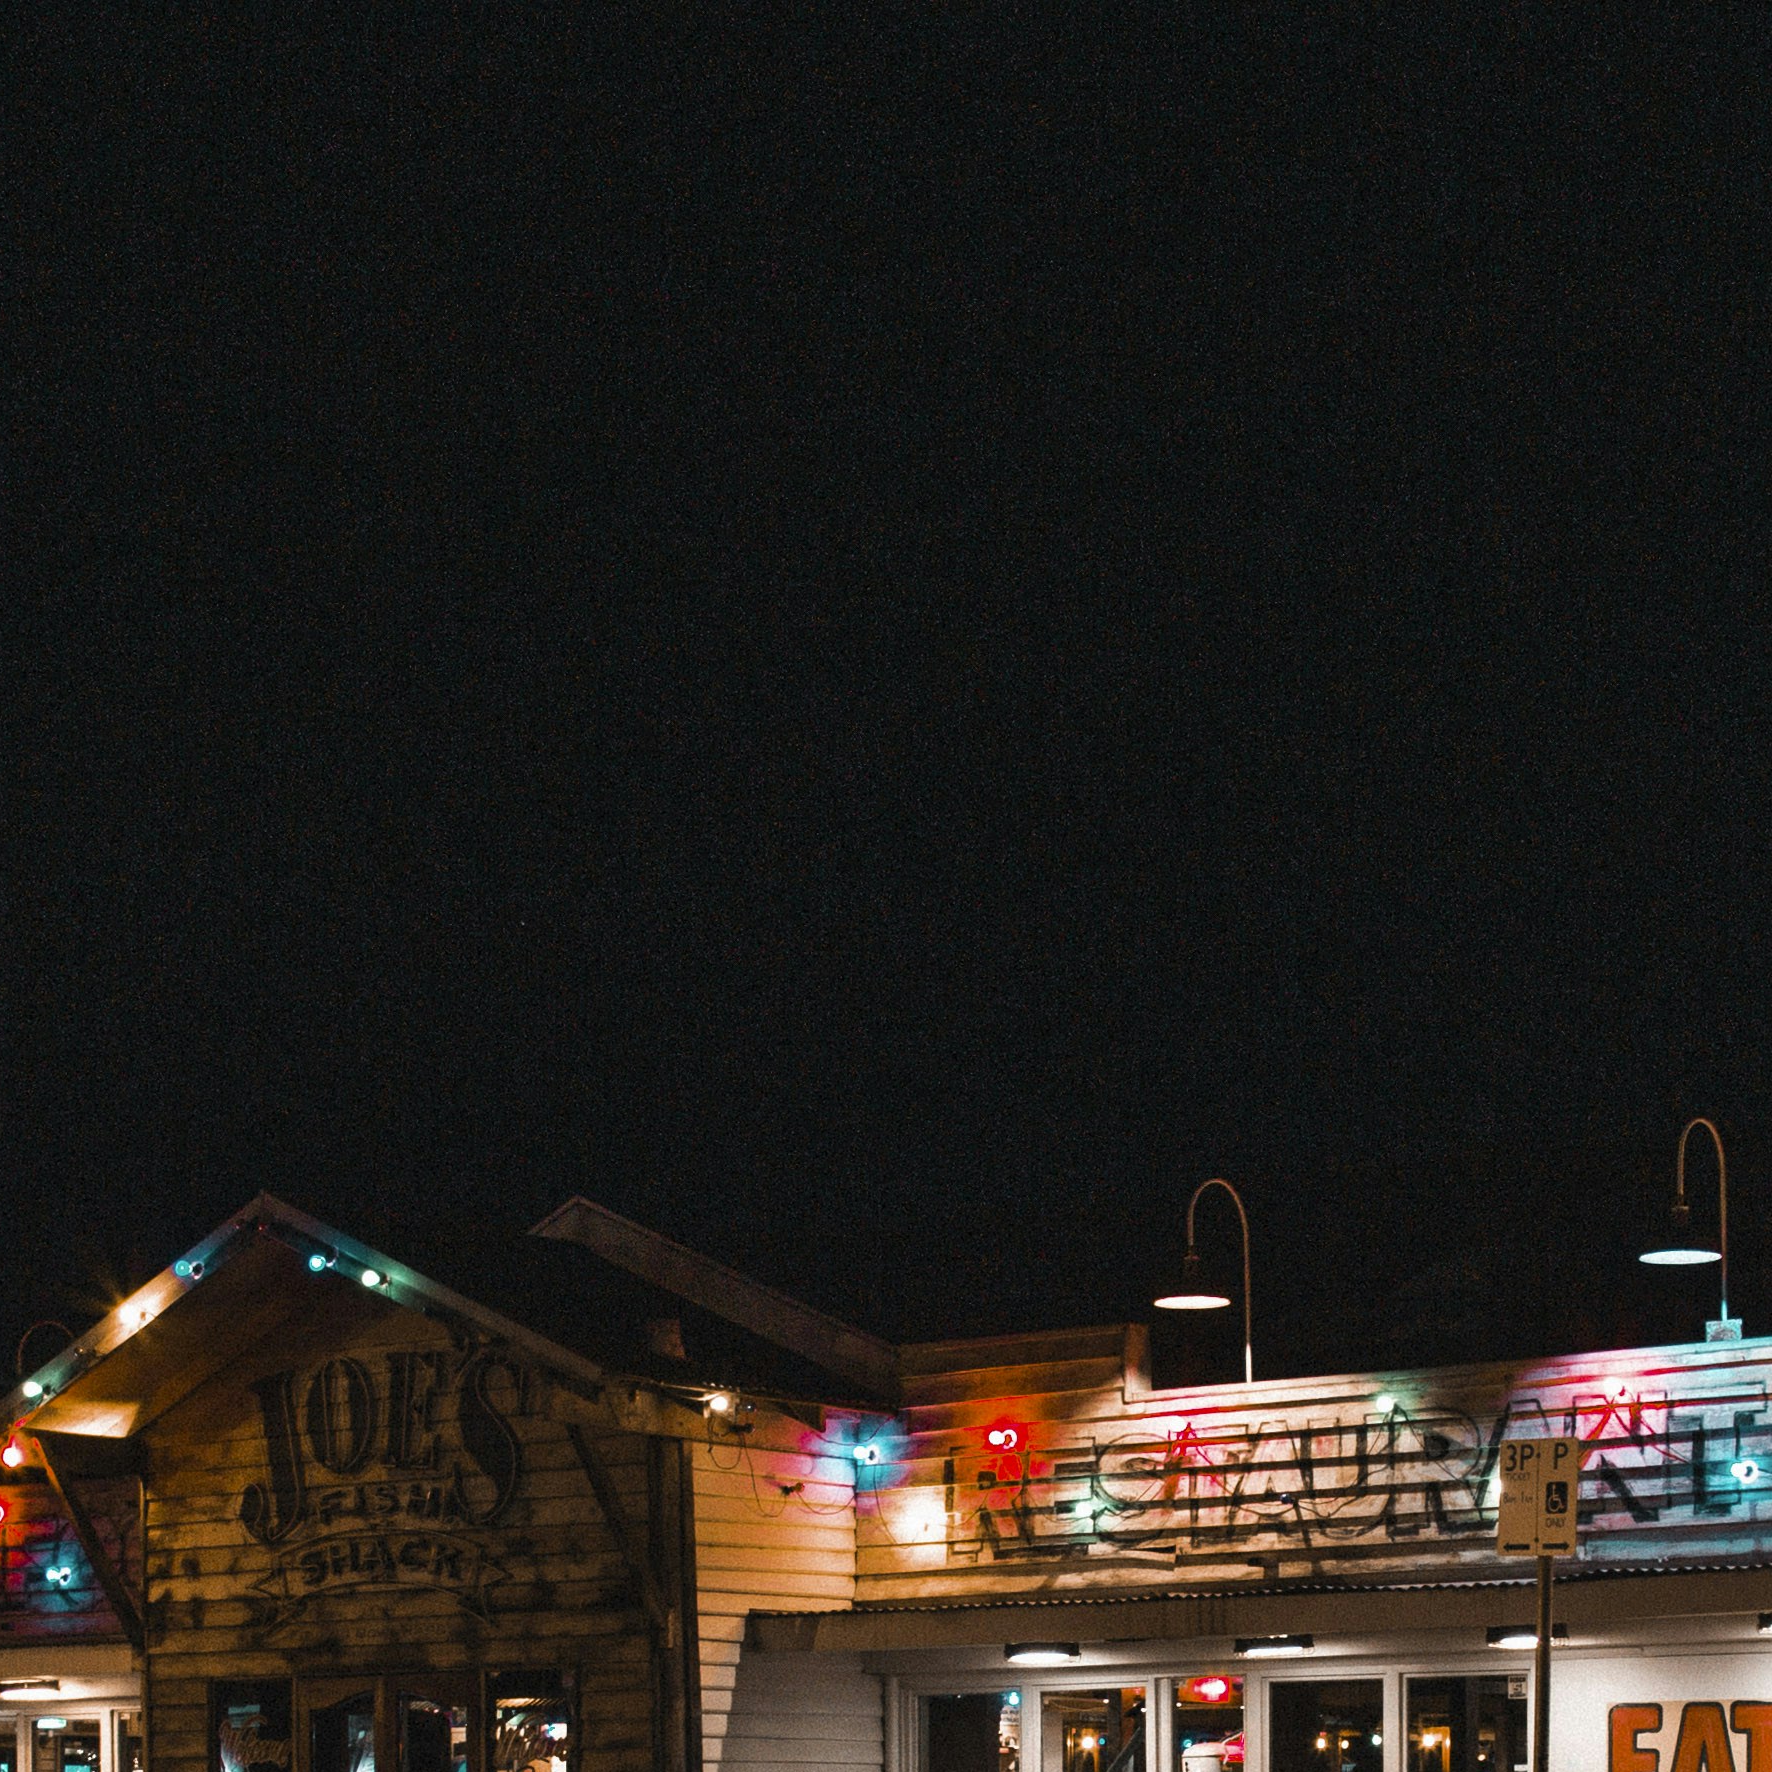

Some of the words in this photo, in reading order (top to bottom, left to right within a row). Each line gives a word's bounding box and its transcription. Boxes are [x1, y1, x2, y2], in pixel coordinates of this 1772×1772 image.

[1505, 1444, 1534, 1472] 3P
[1554, 1442, 1568, 1469] P
[300, 1535, 464, 1586] SHACK
